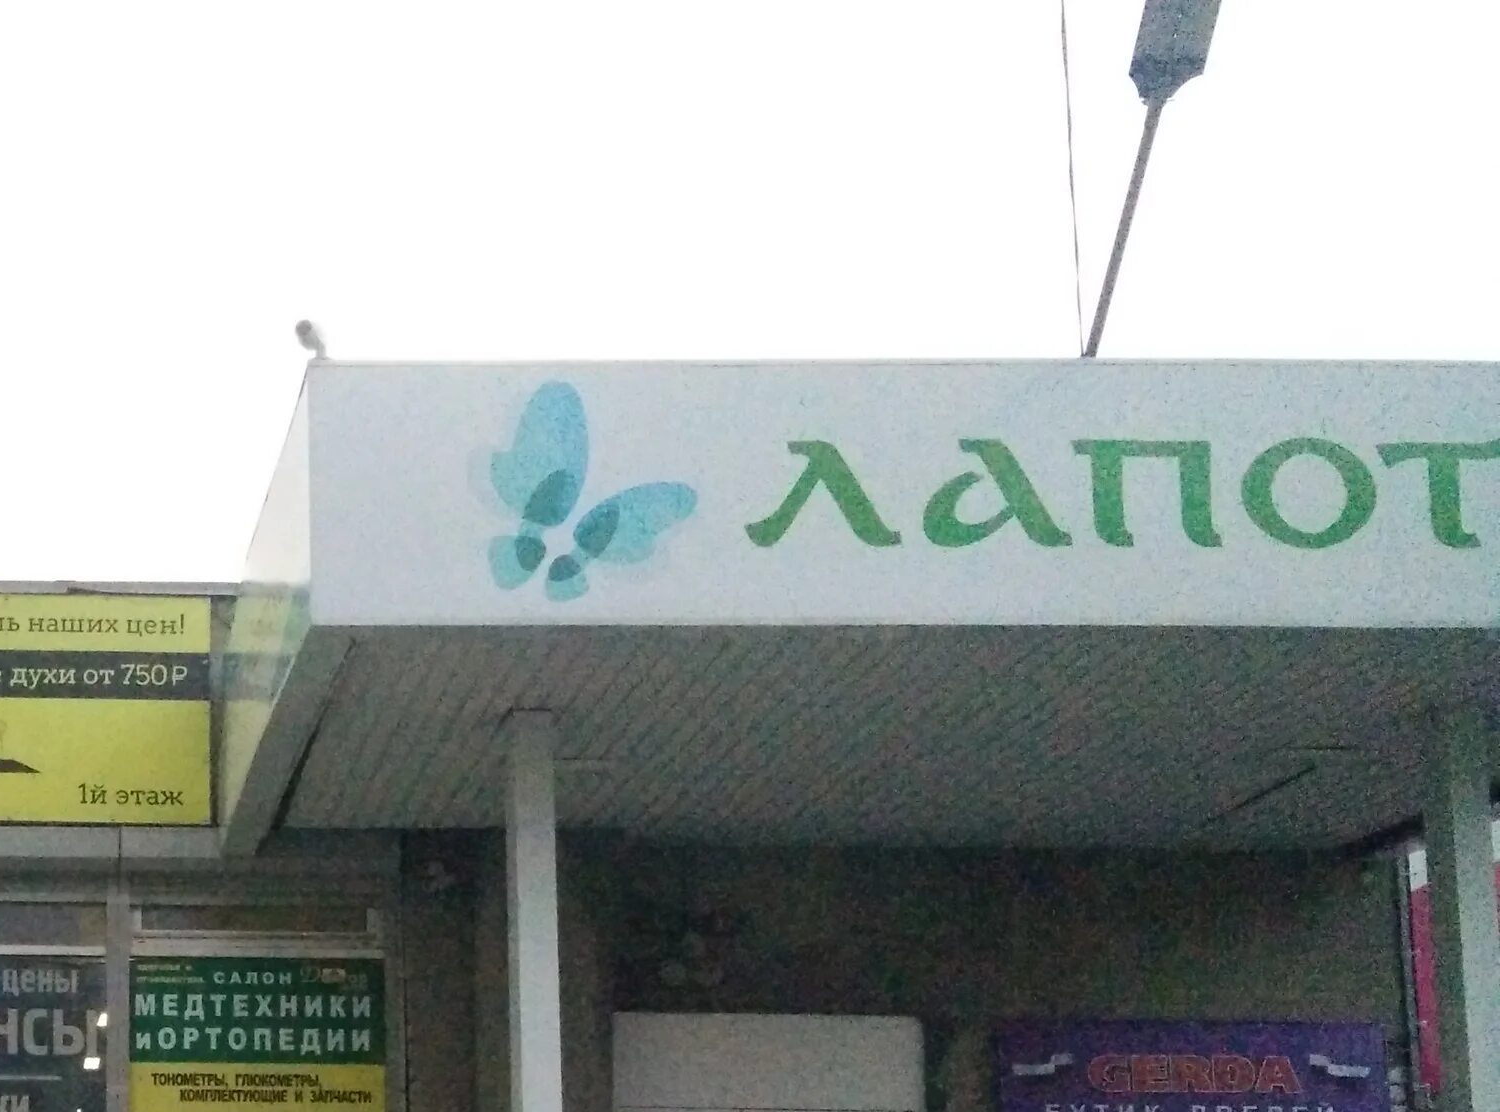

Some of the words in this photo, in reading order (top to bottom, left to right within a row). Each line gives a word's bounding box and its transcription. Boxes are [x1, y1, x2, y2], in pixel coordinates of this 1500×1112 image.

[27, 614, 119, 636] наших
[126, 612, 188, 640] цен!
[8, 665, 77, 691] духи
[82, 665, 115, 686] от
[77, 783, 108, 806] 1й
[115, 786, 185, 808] этаж
[212, 970, 293, 985] САЛОН
[133, 993, 371, 1021] МЕДТЕХНИКИ
[156, 1026, 371, 1056] ОРТОПЕДИИ
[1087, 1053, 1302, 1094] GERDA
[179, 1089, 288, 1105] КОМПЛЕКТУЮЩИЕ
[309, 1090, 372, 1104] ЗАПЧАСТИ
